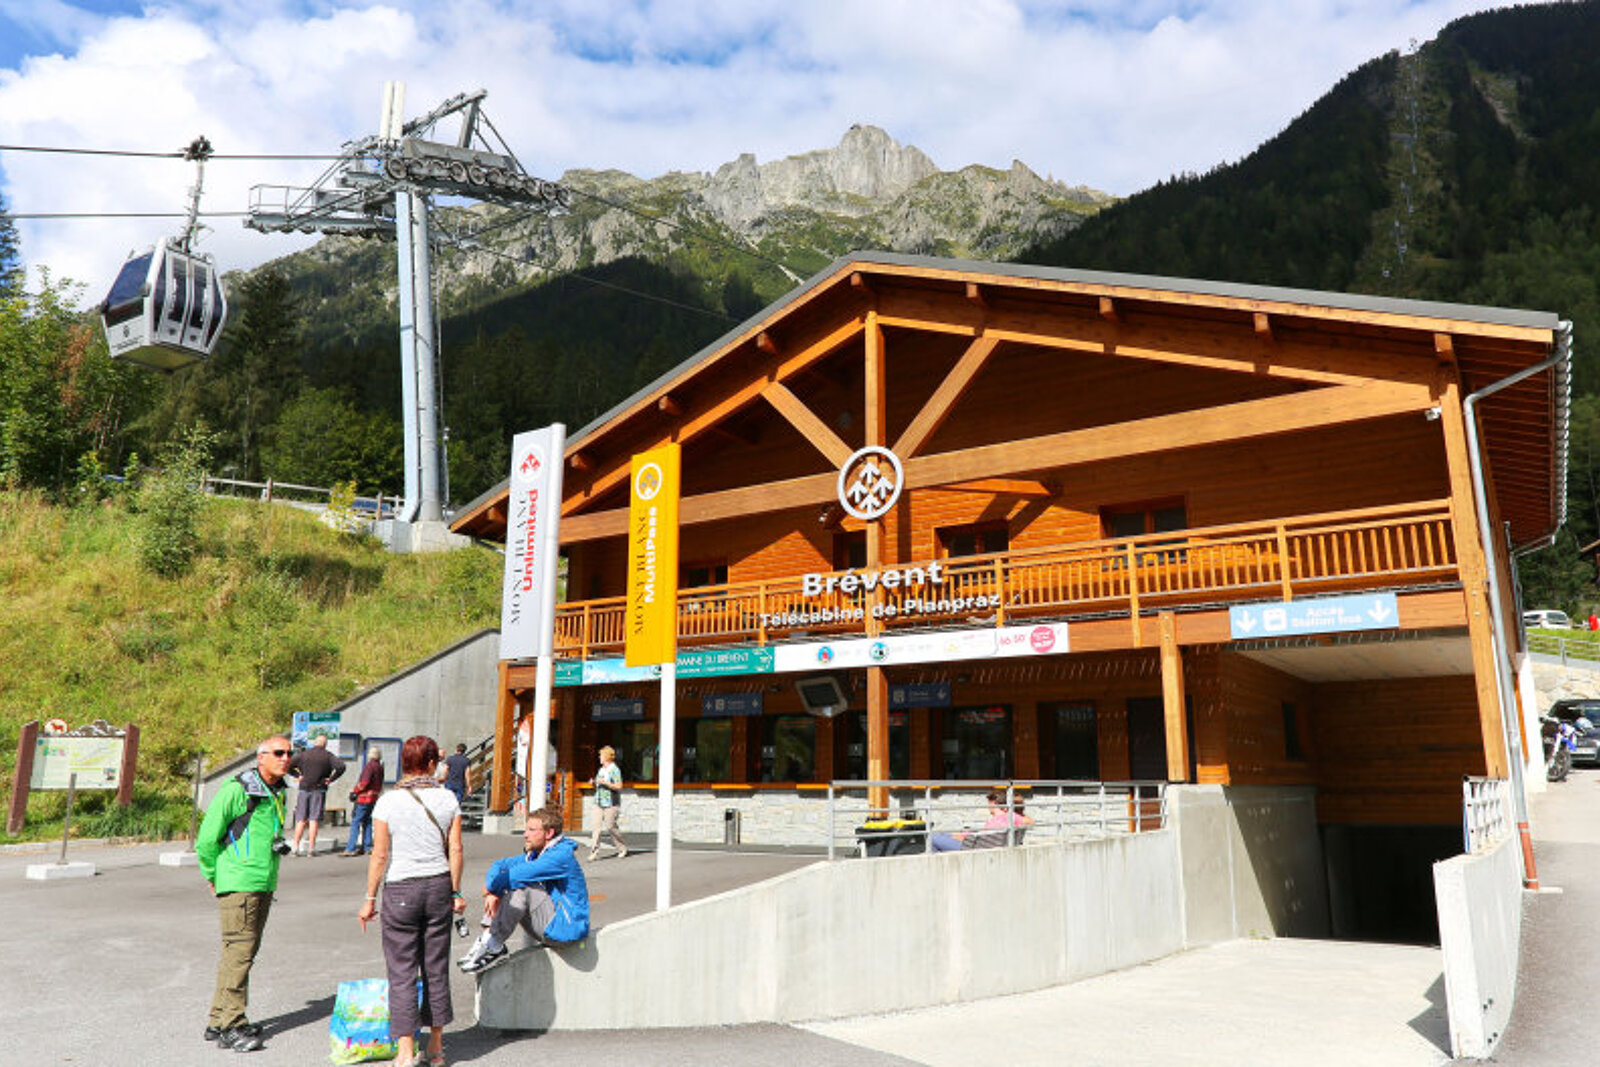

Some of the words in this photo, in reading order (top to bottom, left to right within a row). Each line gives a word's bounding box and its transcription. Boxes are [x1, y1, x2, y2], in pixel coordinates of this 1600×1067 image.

[522, 488, 539, 592] Unlimited
[802, 560, 944, 597] Brévent
[759, 605, 865, 629] Télécabine
[872, 601, 897, 618] de
[904, 593, 1002, 615] Planpraz
